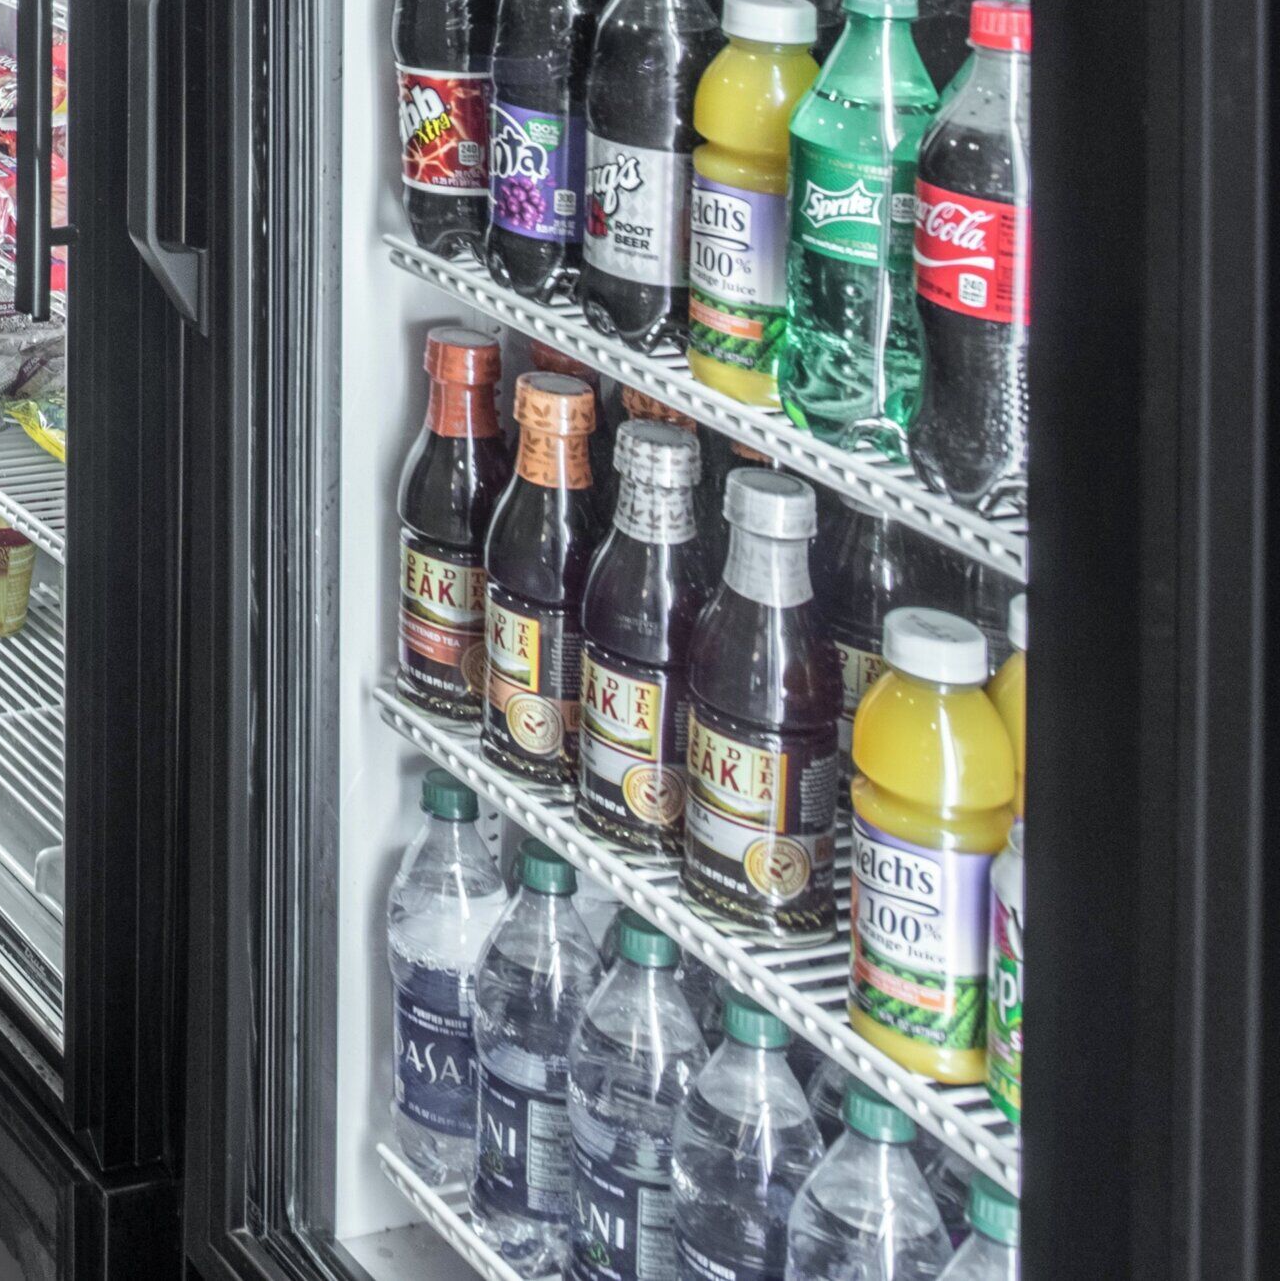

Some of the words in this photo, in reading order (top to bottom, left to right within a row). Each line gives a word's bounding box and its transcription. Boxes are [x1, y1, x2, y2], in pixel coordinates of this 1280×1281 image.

[807, 191, 874, 217] Sprite
[614, 220, 653, 237] ROOT
[613, 233, 650, 251] BEER
[722, 278, 757, 296] Juice
[962, 275, 985, 293] 240
[907, 943, 947, 966] Juice
